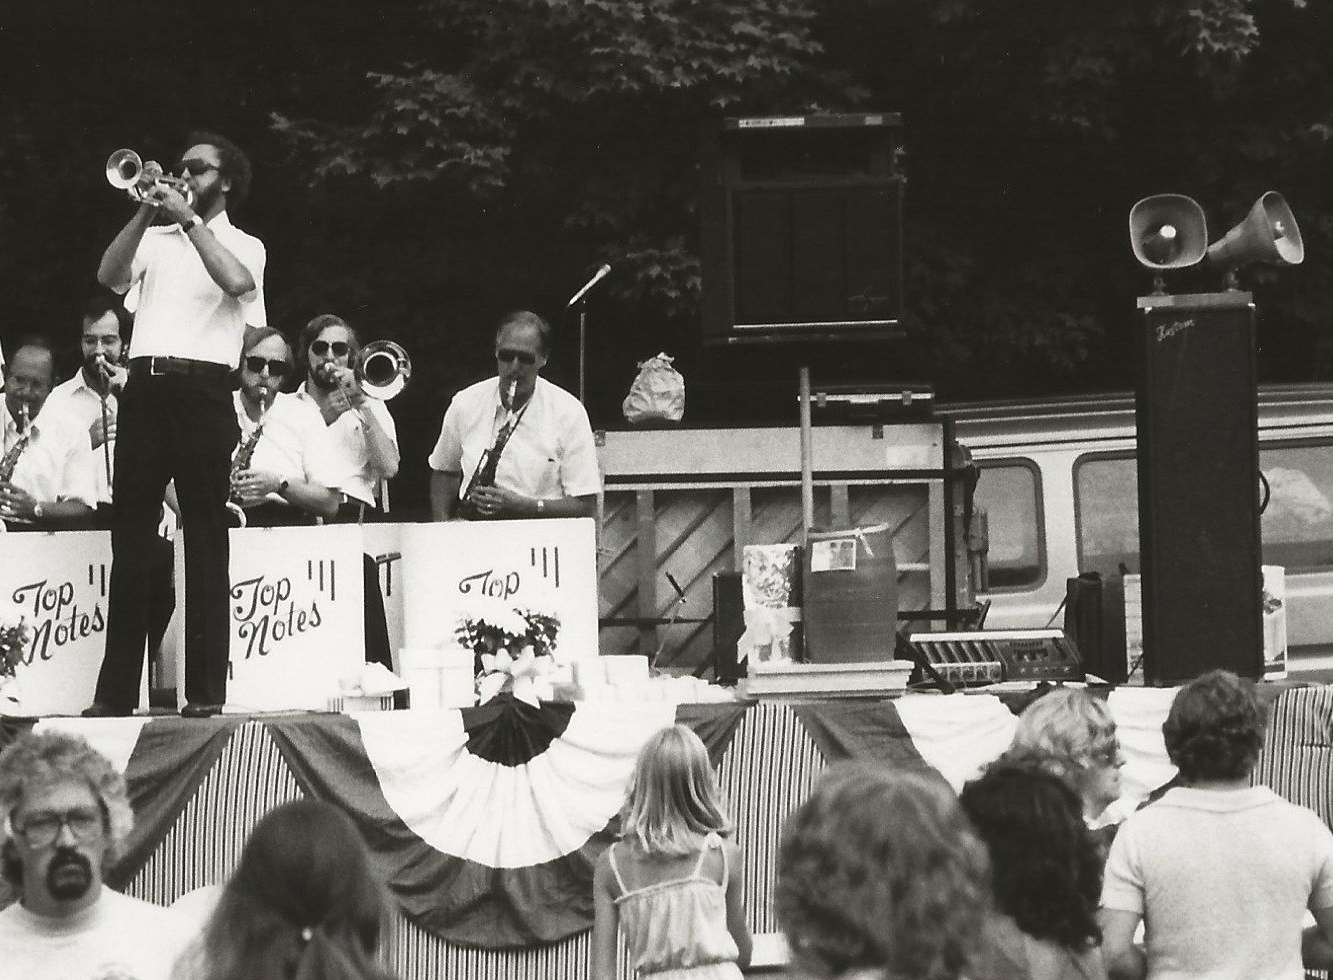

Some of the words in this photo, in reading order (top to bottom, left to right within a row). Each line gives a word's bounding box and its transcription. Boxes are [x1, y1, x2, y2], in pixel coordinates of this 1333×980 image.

[12, 579, 74, 620] Top
[230, 575, 291, 622] Top
[458, 569, 520, 601] Top
[30, 602, 105, 665] Notes
[238, 600, 322, 660] Notes
